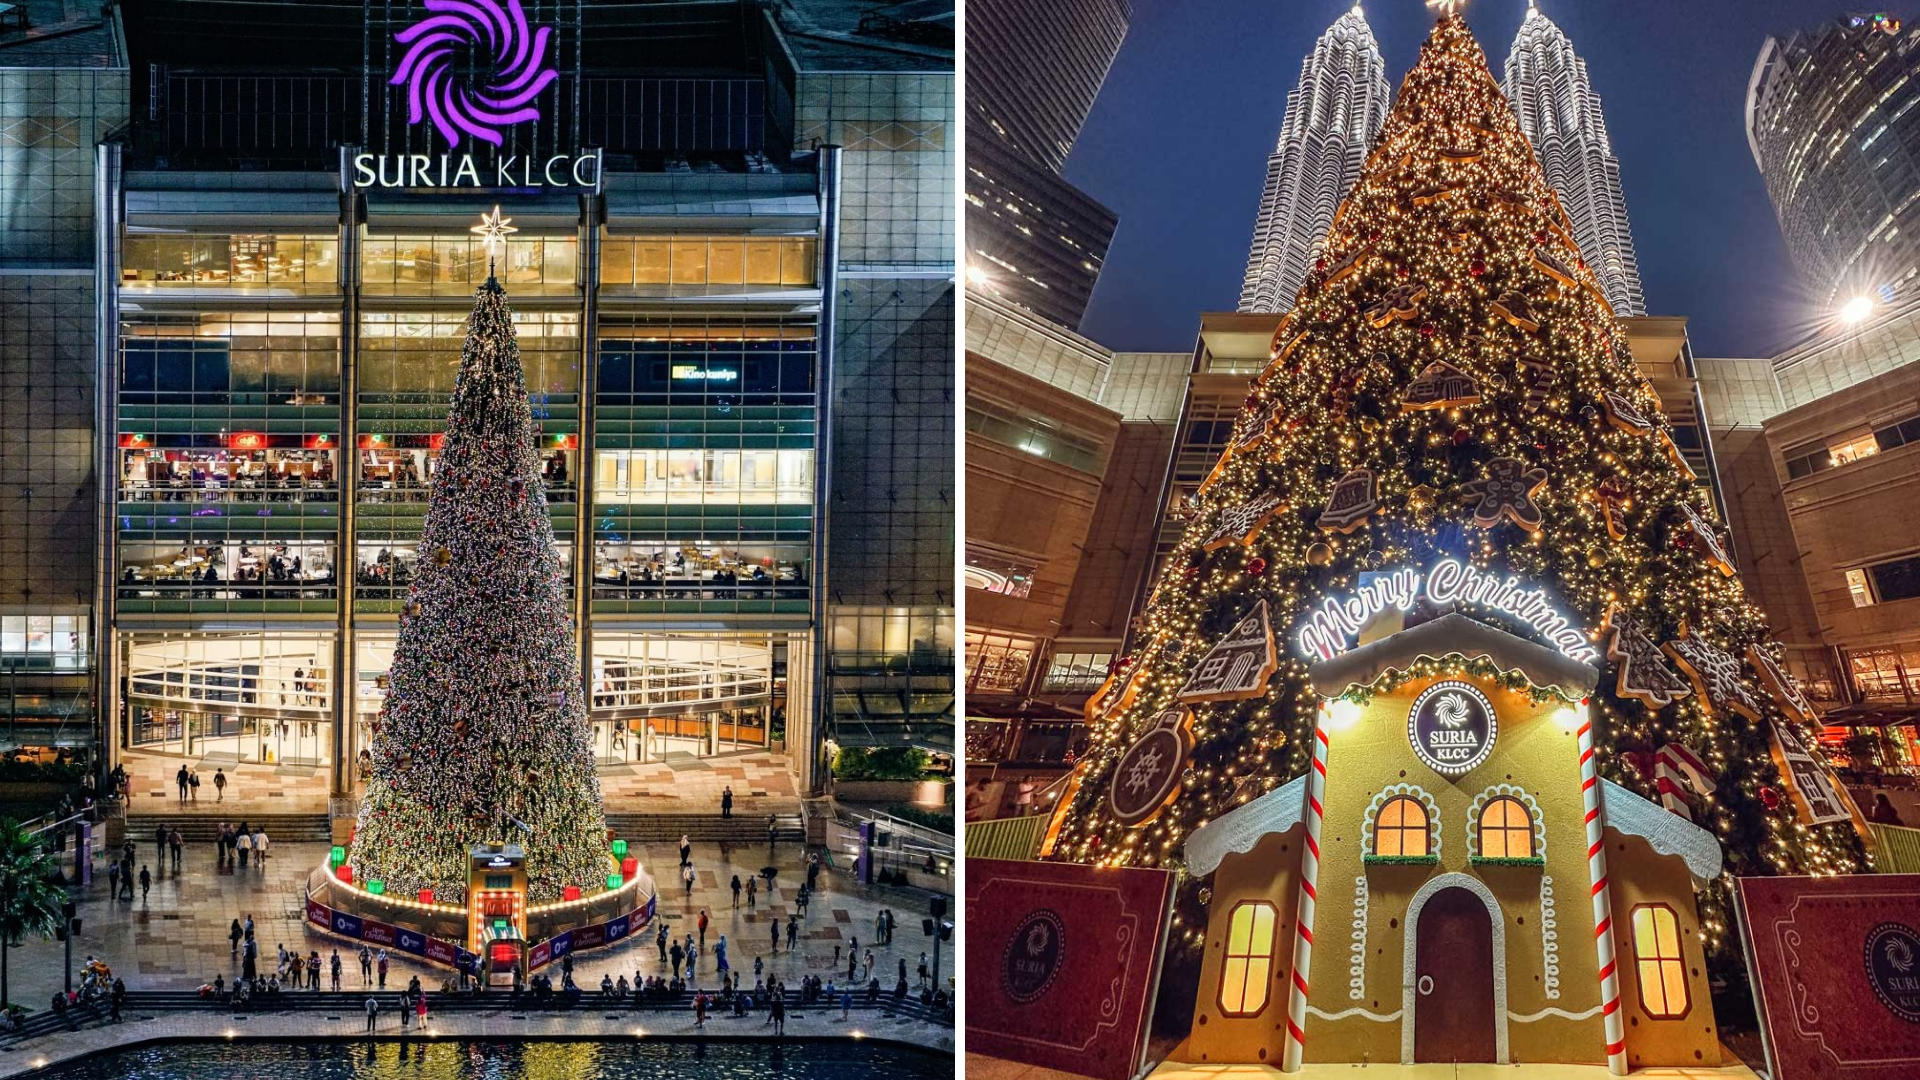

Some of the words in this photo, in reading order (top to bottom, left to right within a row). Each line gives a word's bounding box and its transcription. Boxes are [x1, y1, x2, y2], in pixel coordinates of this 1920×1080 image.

[354, 154, 481, 188] SURIA
[498, 154, 597, 187] KLCC
[1299, 568, 1420, 661] Merry
[1426, 559, 1597, 665] Christmas
[1429, 730, 1477, 744] SURIA
[1436, 748, 1470, 760] KLCC
[1888, 976, 1920, 990] SURI
[1899, 996, 1920, 1007] KLC
